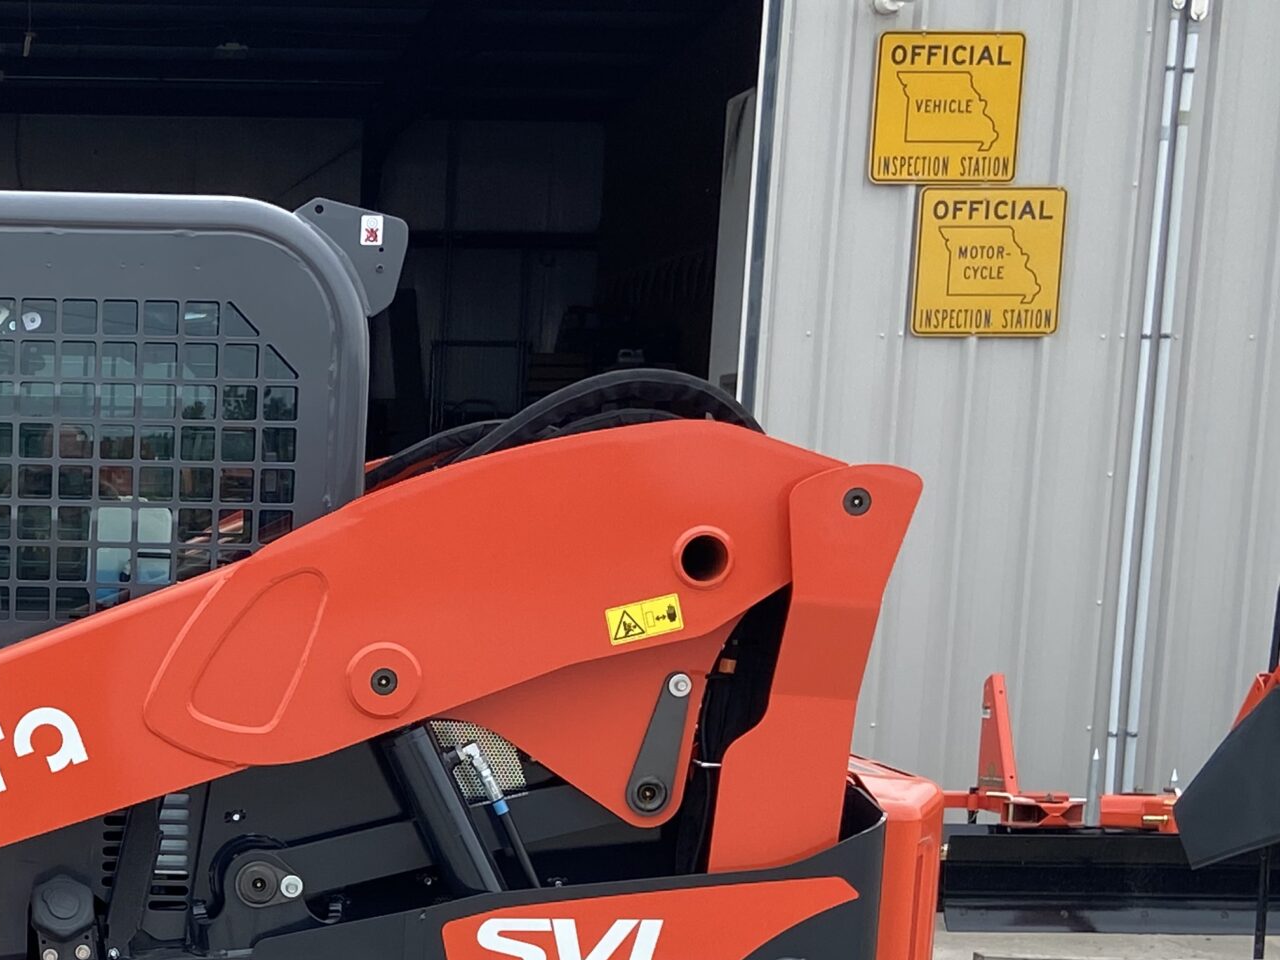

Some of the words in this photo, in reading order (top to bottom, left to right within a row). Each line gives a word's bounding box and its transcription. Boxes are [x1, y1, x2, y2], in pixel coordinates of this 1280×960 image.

[891, 44, 1012, 66] OFFICIAL
[915, 99, 973, 114] VEHICLE
[877, 155, 949, 178] INSPECTION
[959, 156, 1010, 178] STATION
[932, 199, 1054, 221] OFFICIAL
[958, 245, 1011, 260] MOTOR-
[963, 266, 1005, 281] CYCLE
[920, 309, 992, 330] INSPECTION
[1001, 309, 1052, 330] STATION
